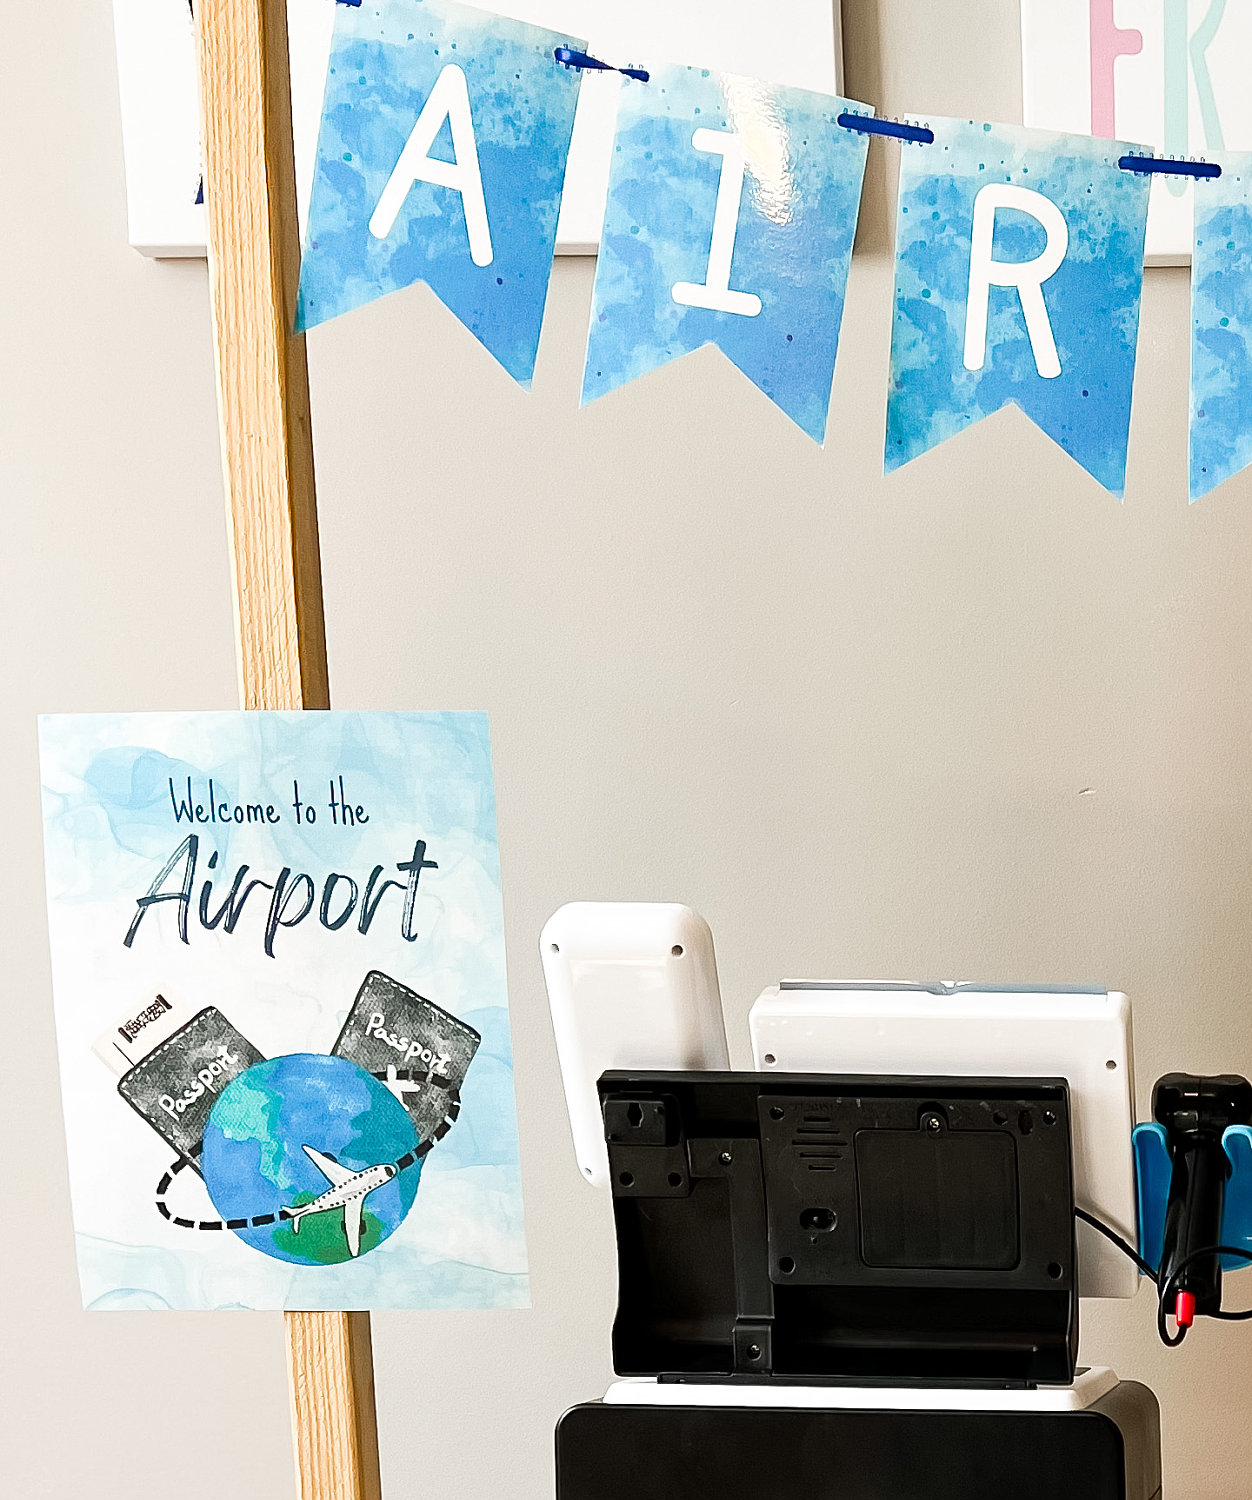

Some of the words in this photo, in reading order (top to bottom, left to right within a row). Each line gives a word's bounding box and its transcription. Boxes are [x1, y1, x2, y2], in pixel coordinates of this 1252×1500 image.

[168, 775, 281, 824] Welcome
[292, 779, 317, 825] to
[328, 775, 370, 826] the
[122, 833, 439, 959] Airport
[365, 1012, 452, 1074] Passport
[158, 1045, 239, 1122] Passport
